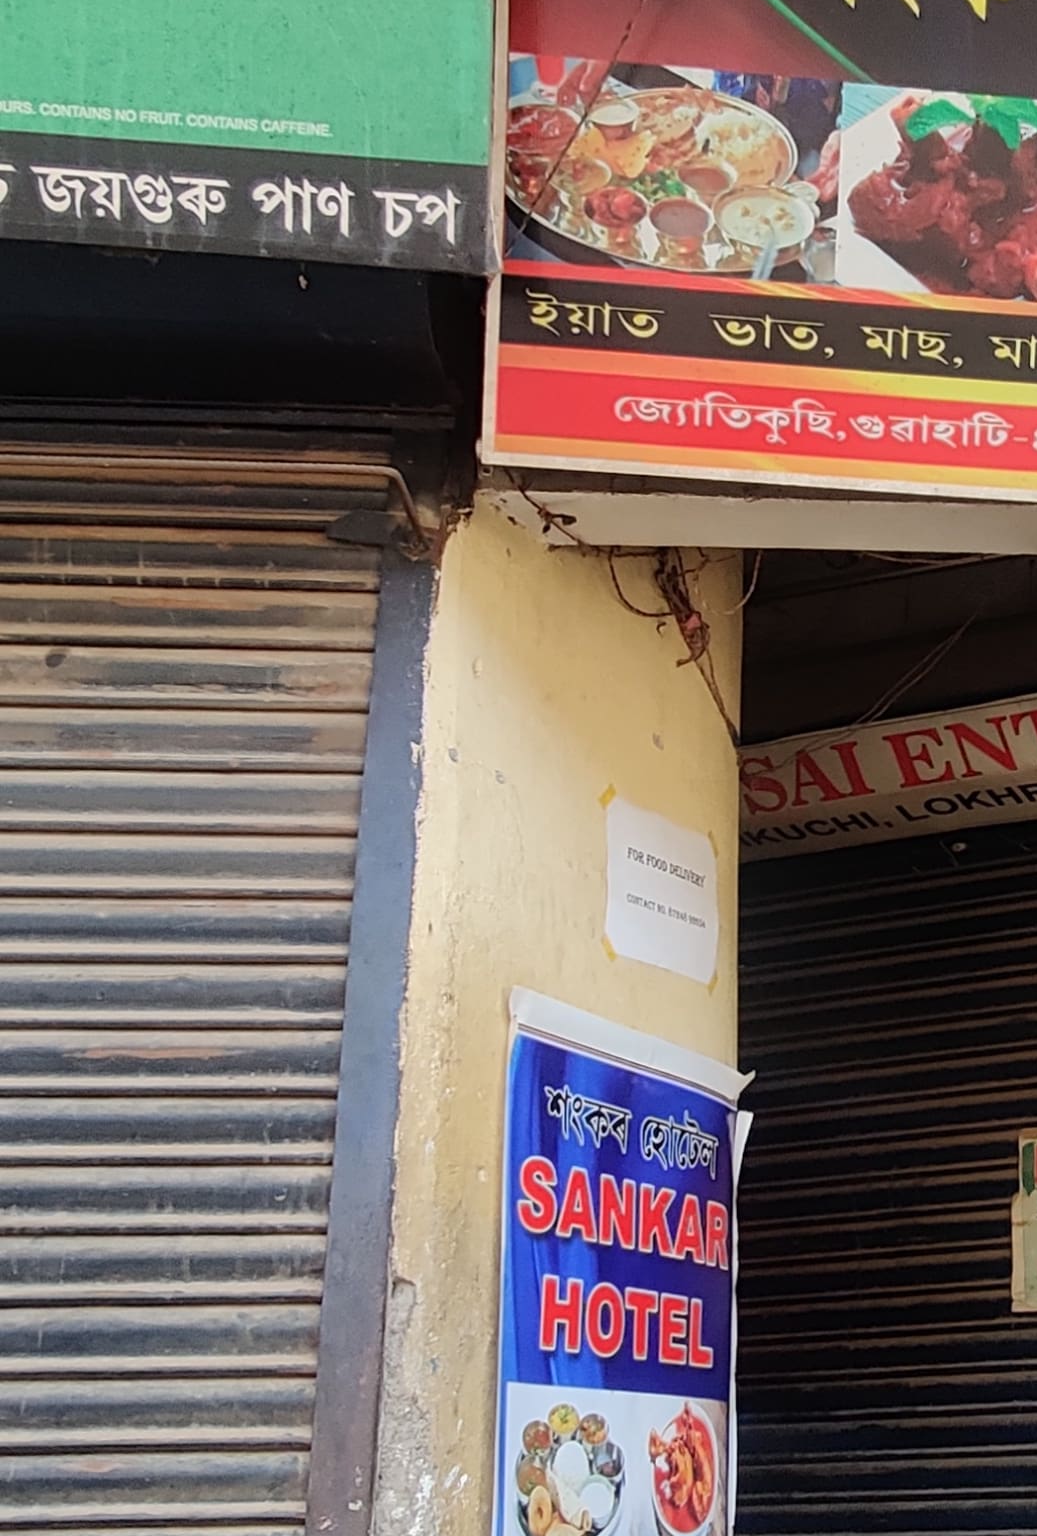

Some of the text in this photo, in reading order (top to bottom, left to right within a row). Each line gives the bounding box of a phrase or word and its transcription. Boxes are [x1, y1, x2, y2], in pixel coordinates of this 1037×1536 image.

[0, 101, 334, 138] URS. CONTAINS NO FRUIT. CONTAINS CAFFEINE.
[30, 165, 232, 227] জয়গুৰু
[252, 175, 355, 238] পাণ
[373, 186, 462, 246] চপ
[527, 288, 666, 338] ইয়াত
[710, 313, 836, 360] ভাত,
[859, 324, 965, 370] মাছ,
[740, 741, 876, 816] SAI
[626, 893, 656, 912] CONTACT
[627, 847, 706, 888] FOR FOOD DELIVERY
[544, 1085, 719, 1180] শংকৰ হোটেল
[517, 1154, 730, 1271] SANKAR
[538, 1273, 714, 1368] HOTEL
